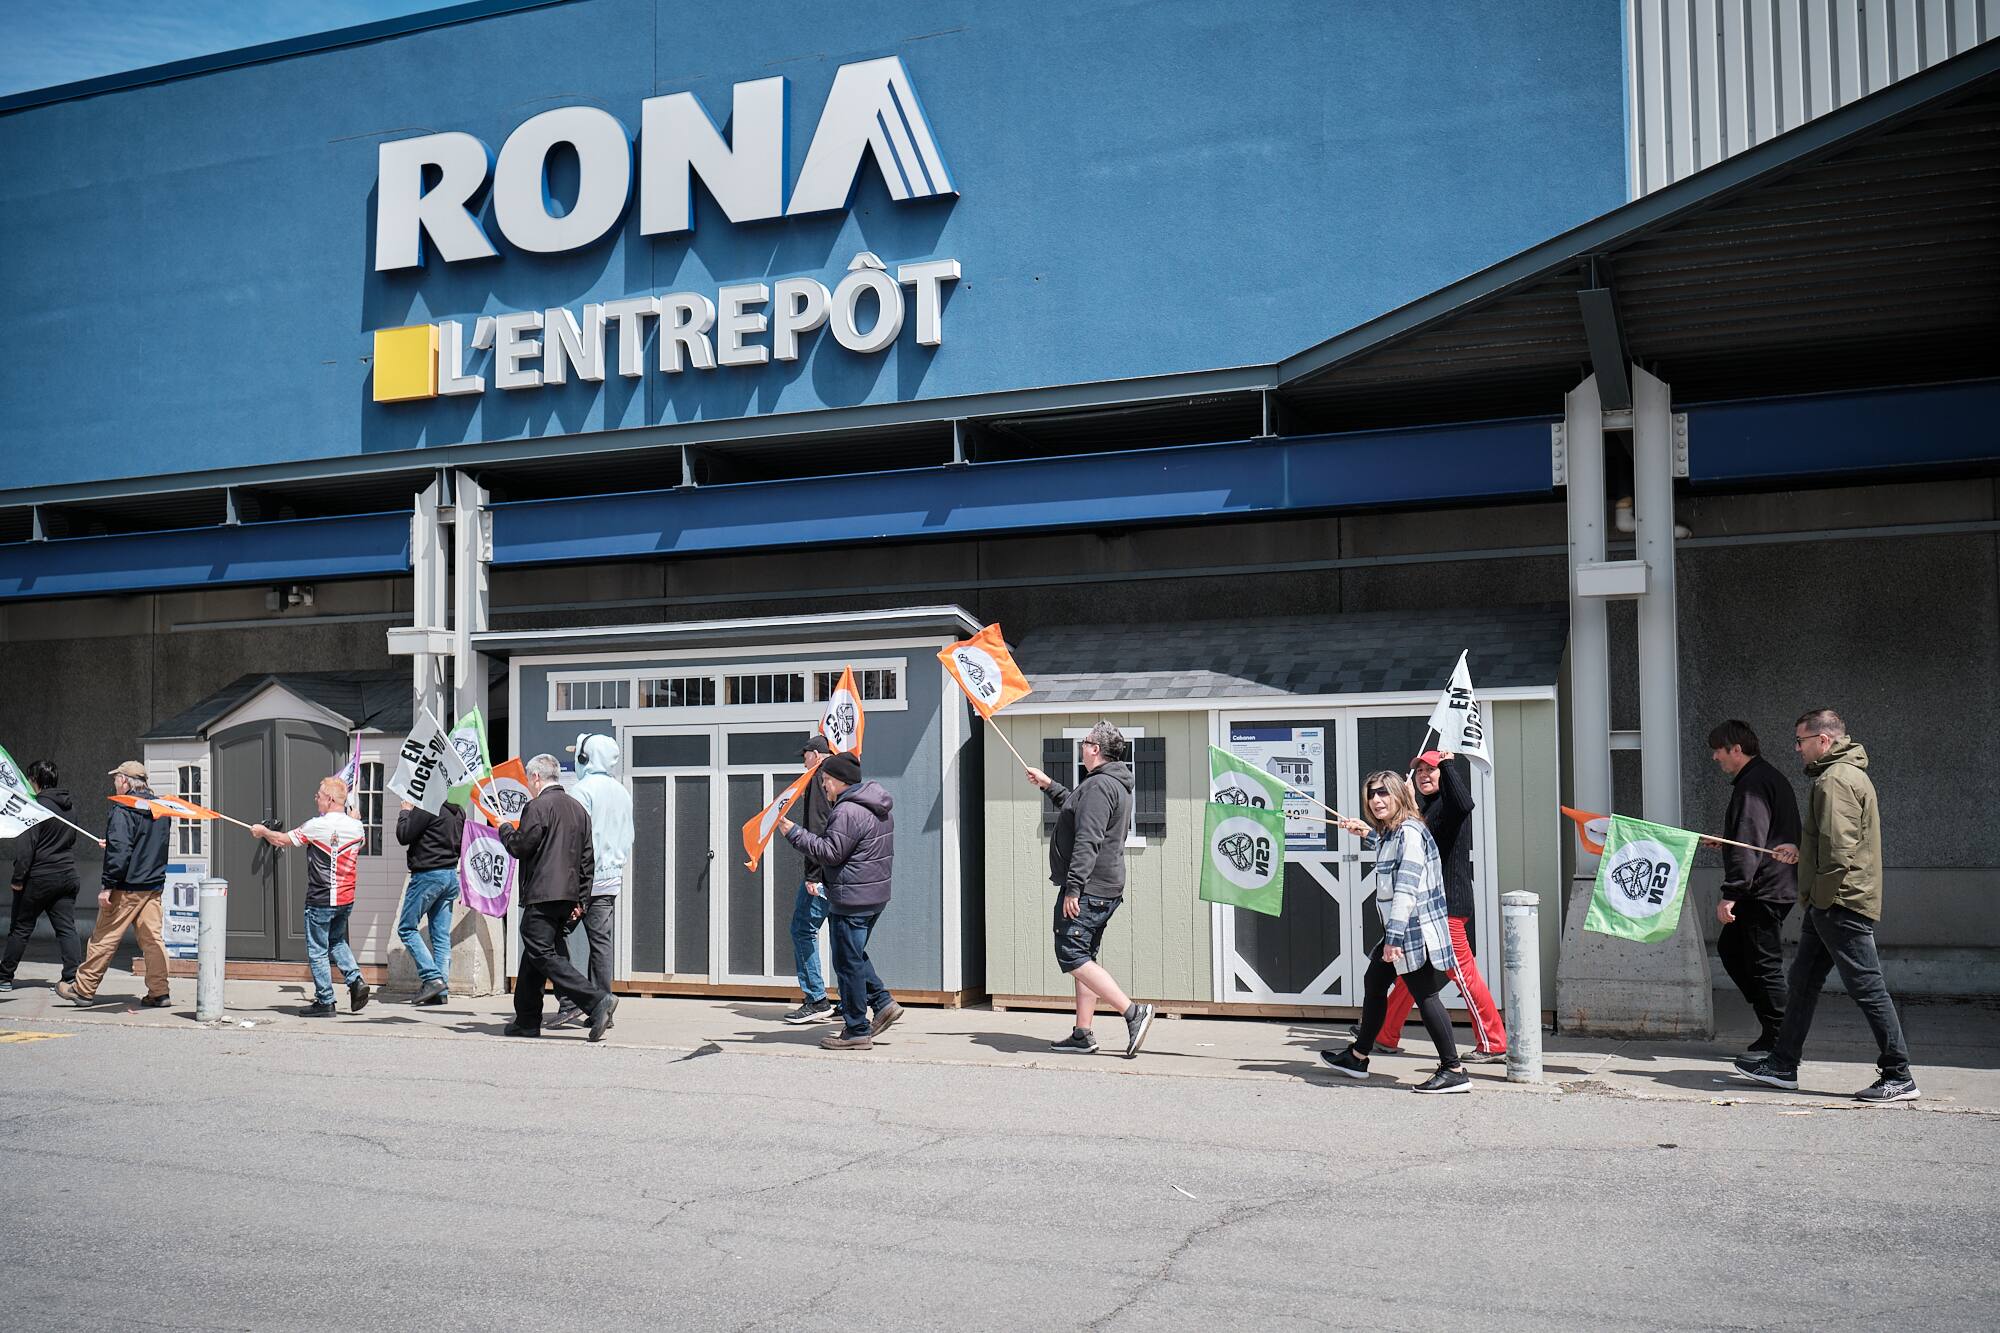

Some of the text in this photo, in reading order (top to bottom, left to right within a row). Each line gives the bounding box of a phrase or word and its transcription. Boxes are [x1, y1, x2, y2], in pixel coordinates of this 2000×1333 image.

[375, 55, 959, 272] RONA
[438, 252, 962, 395] L'ENTREPÔT
[1448, 687, 1472, 710] EN
[826, 713, 842, 745] CSN
[401, 739, 426, 764] EN
